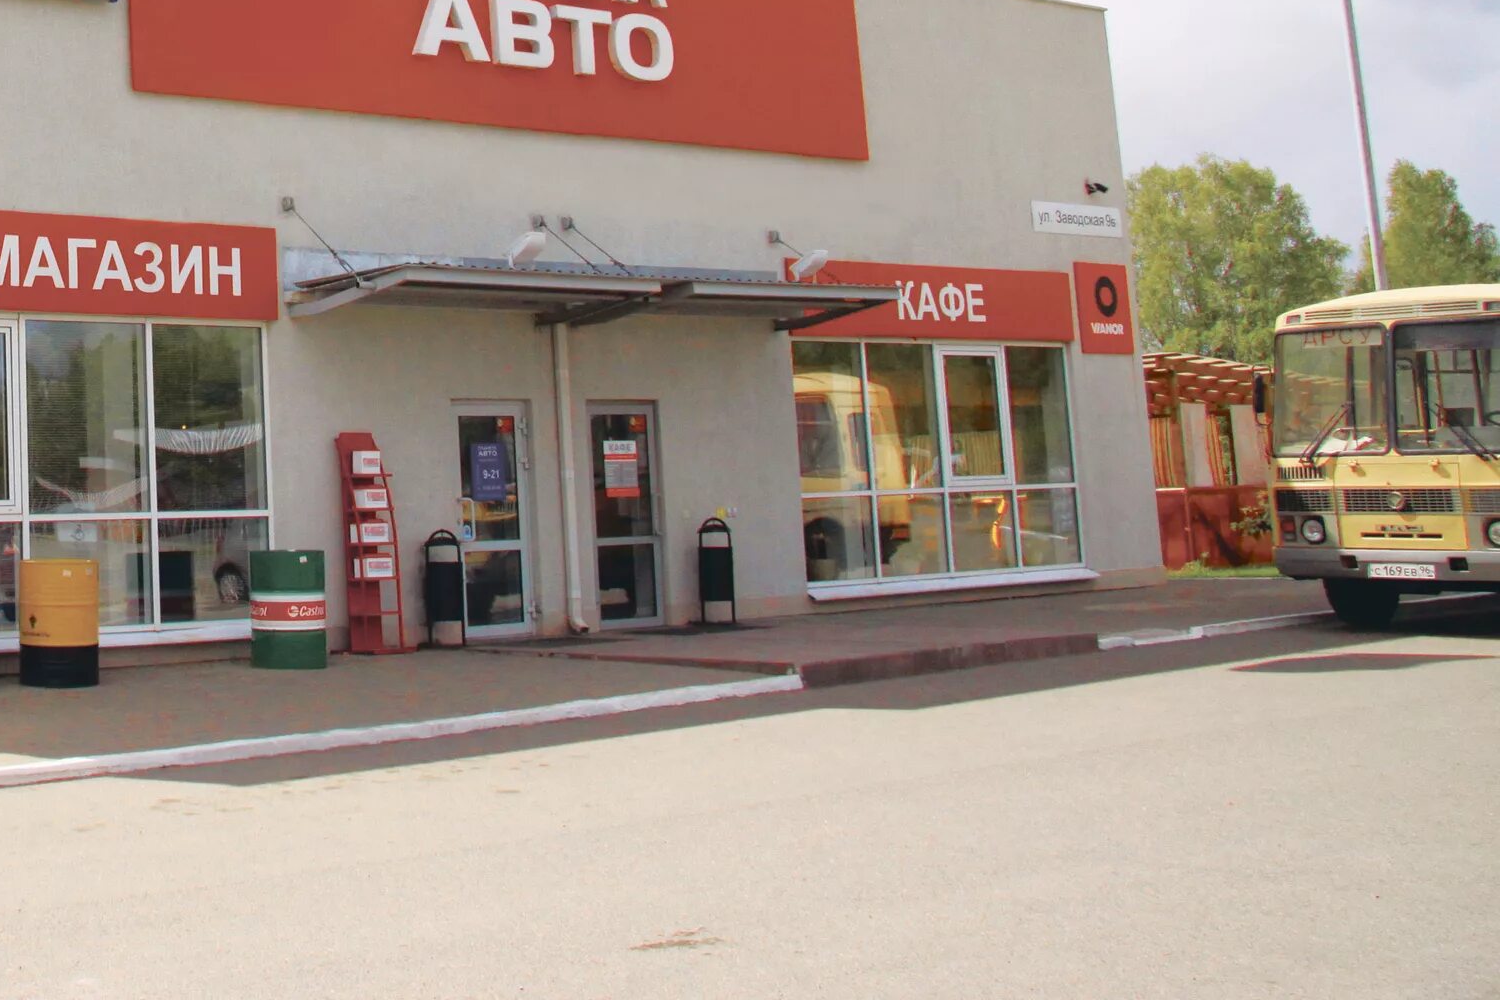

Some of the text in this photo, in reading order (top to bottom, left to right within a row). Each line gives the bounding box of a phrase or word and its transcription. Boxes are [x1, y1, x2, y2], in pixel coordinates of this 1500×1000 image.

[1055, 210, 1104, 227] Заводская
[895, 280, 987, 322] КАФЕ
[1090, 321, 1125, 335] VIANOR
